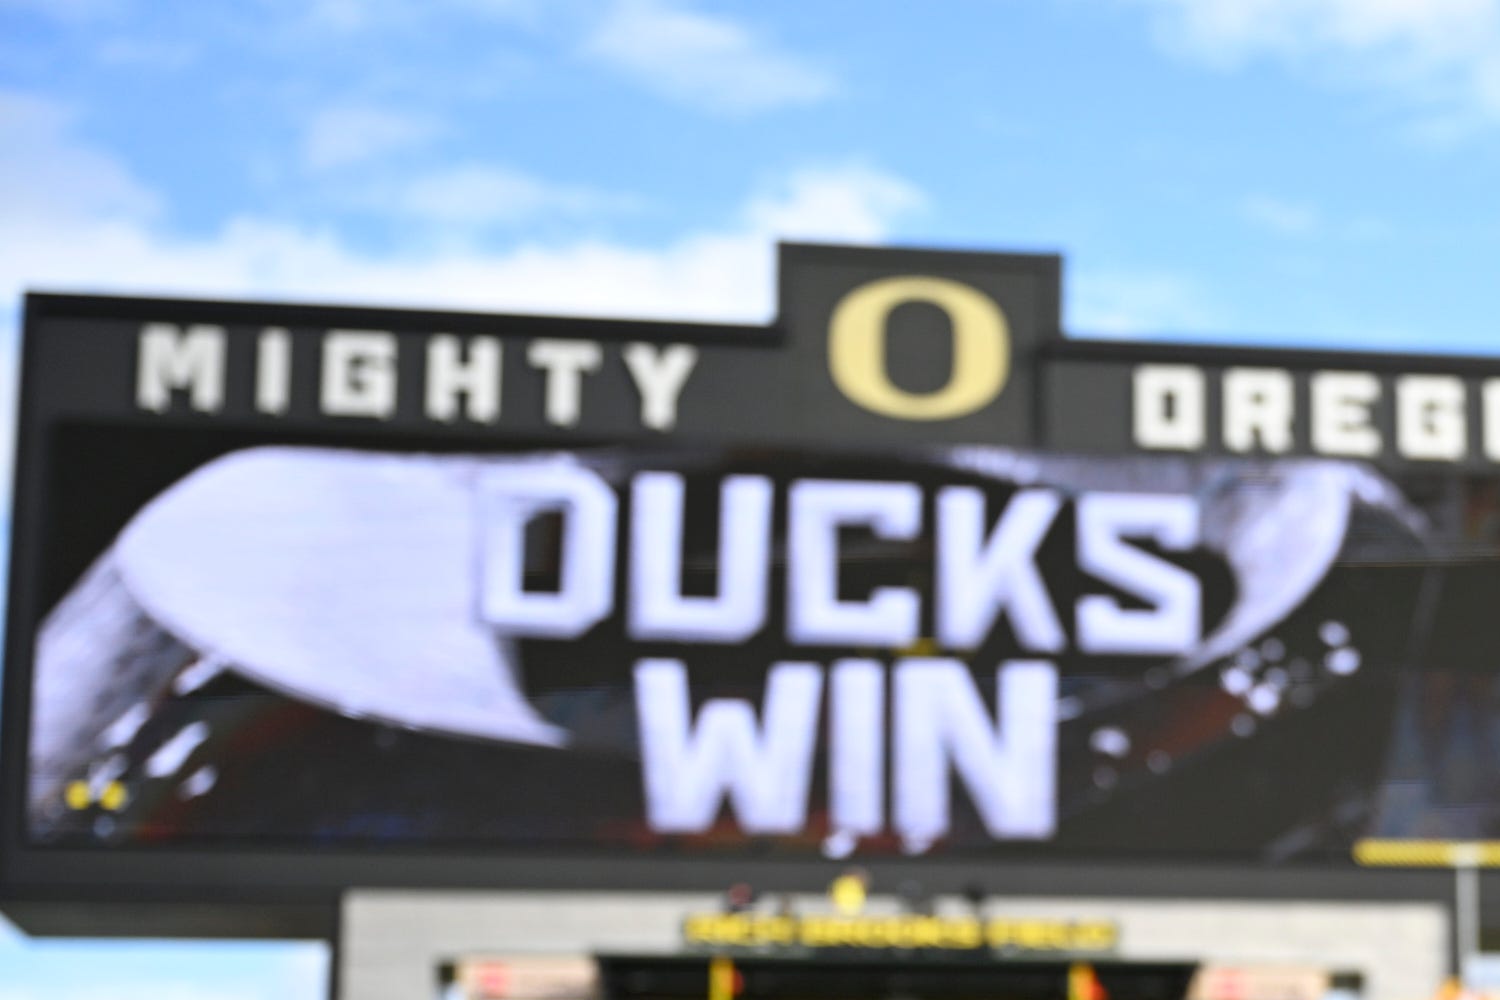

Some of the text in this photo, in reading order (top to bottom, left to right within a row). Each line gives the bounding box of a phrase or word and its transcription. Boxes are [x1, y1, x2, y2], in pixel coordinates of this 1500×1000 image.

[136, 322, 698, 431] MIGHTY
[828, 275, 1012, 423] O
[478, 465, 1203, 656] DUCKS
[633, 657, 1060, 840] WIN
